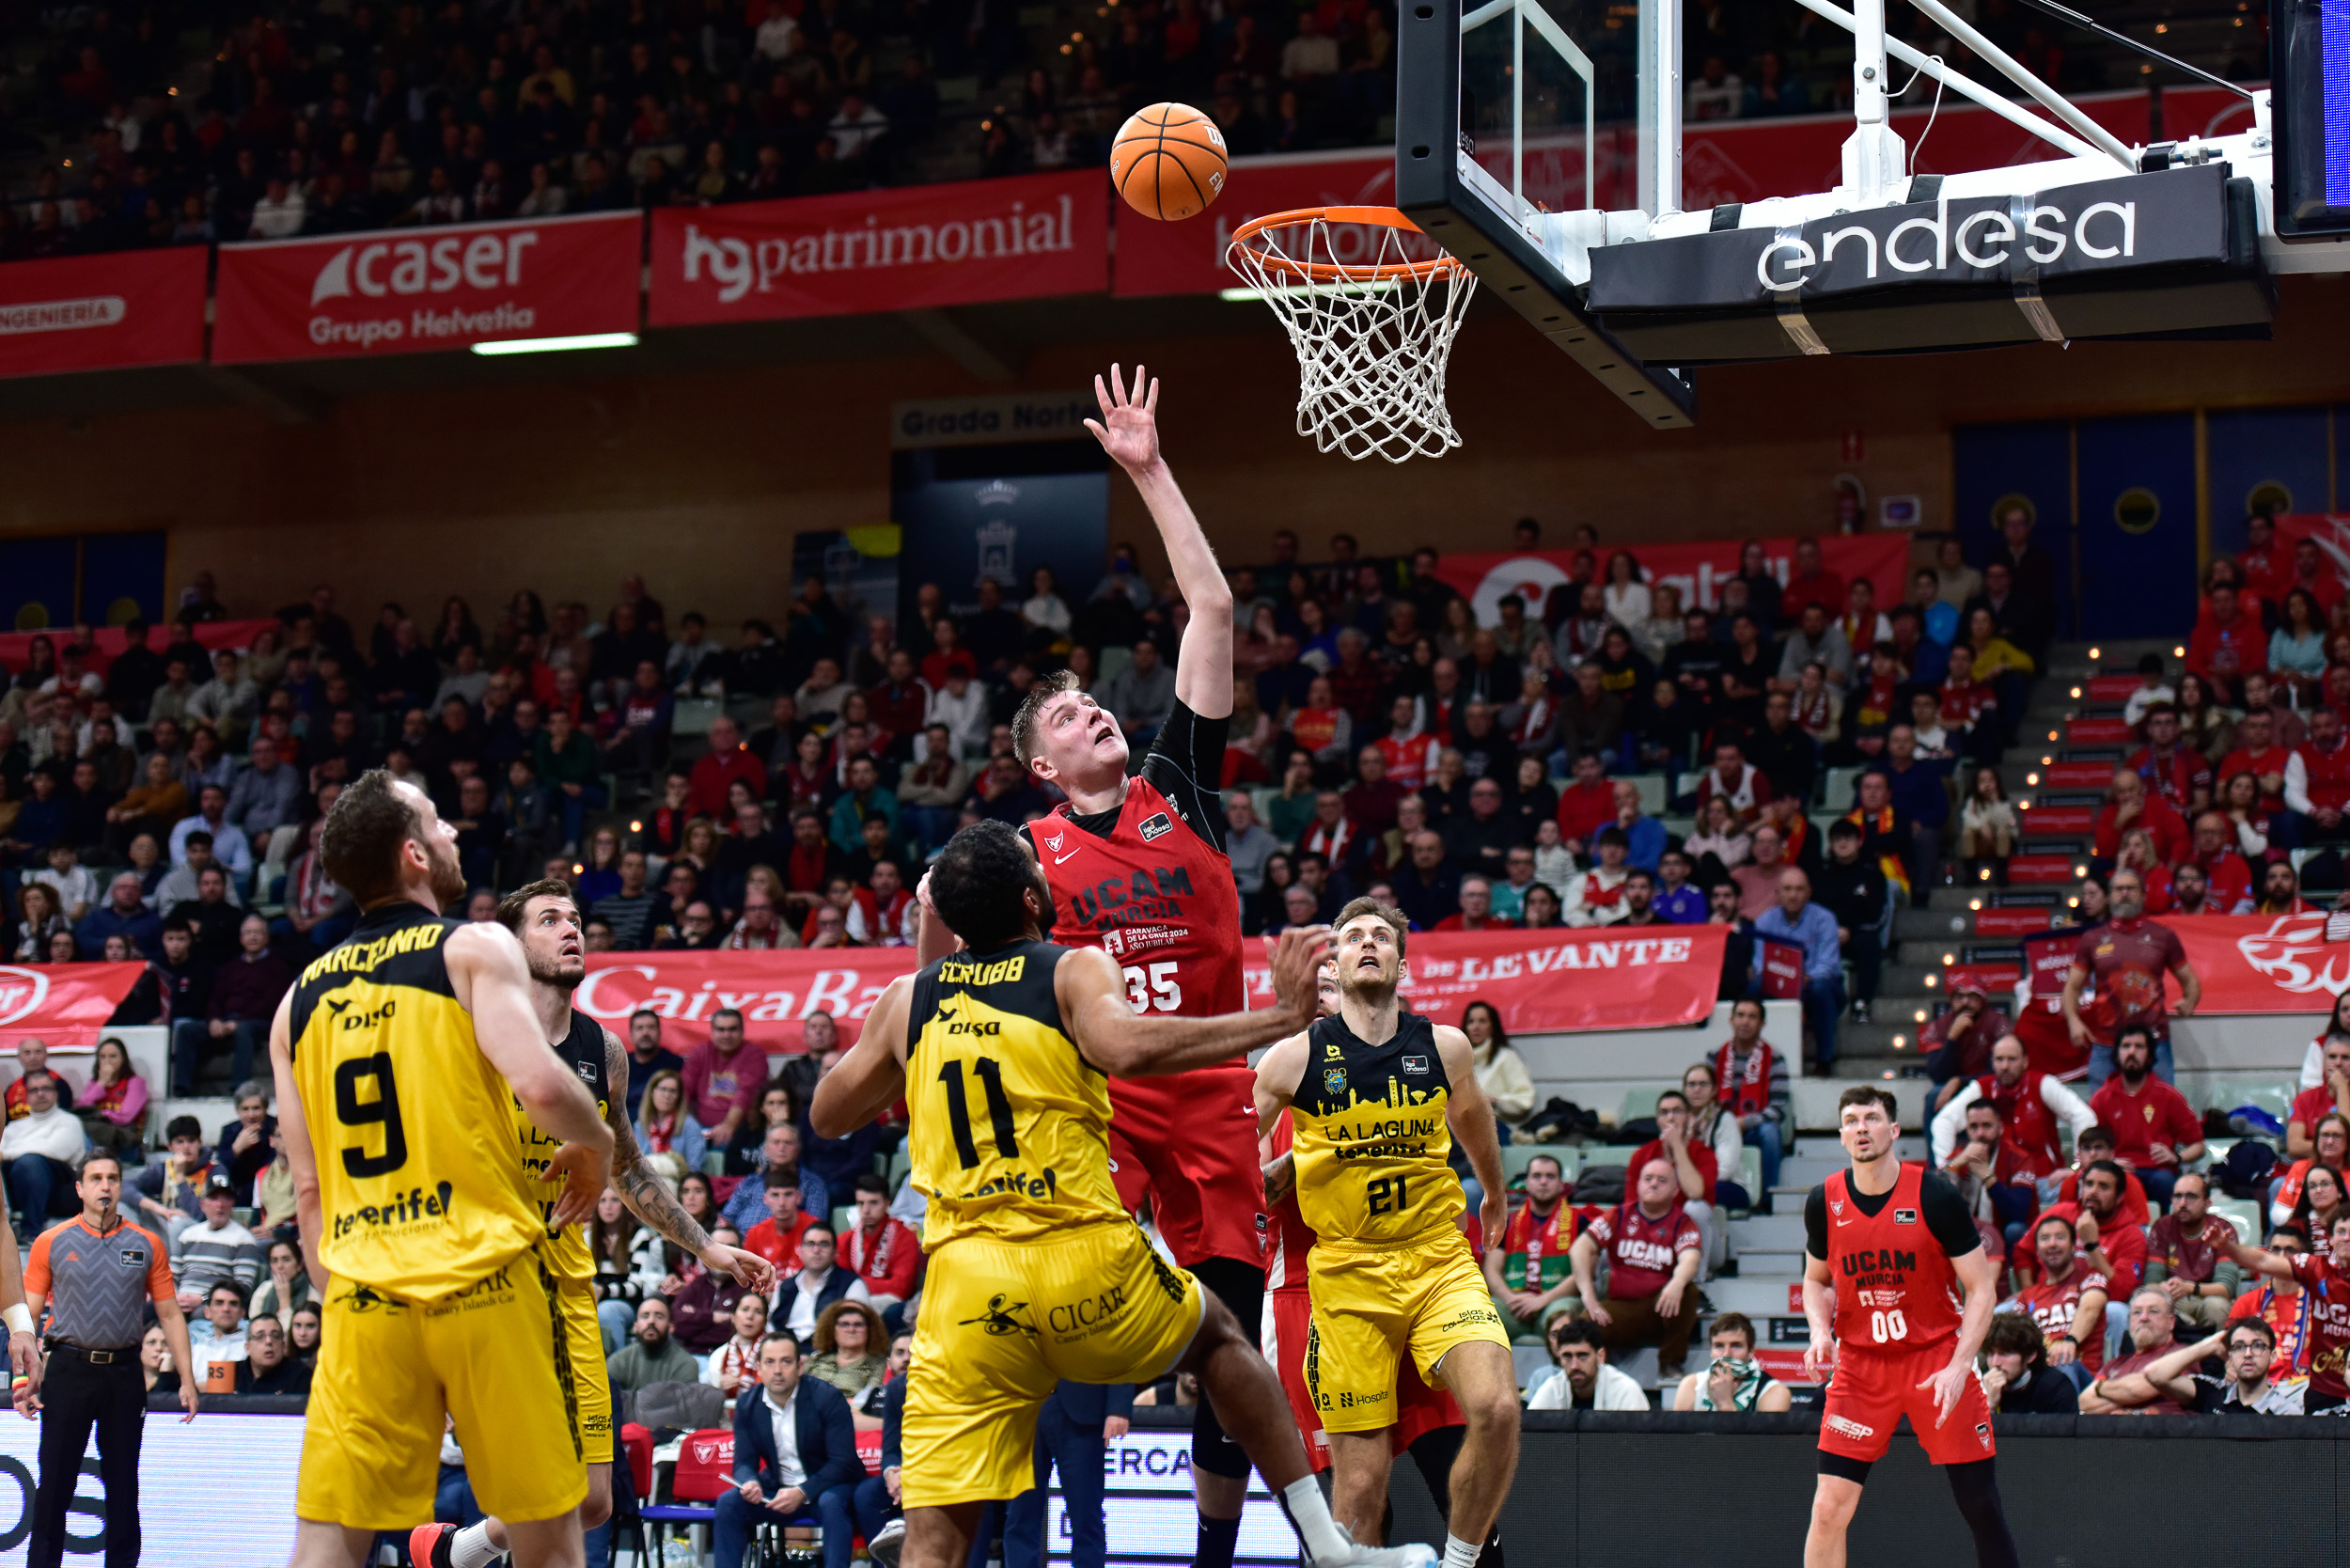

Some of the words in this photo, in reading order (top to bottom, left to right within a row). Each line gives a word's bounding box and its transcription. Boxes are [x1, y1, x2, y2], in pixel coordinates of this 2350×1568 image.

[753, 195, 1074, 292] patrimonial
[1757, 198, 2136, 291] endesa
[354, 231, 538, 297] caser
[309, 318, 403, 349] Grupo
[412, 301, 536, 338] Helvetia
[901, 405, 1000, 437] Grada
[1071, 865, 1195, 926] UCAM
[1096, 900, 1183, 933] MURCIA
[1125, 924, 1168, 935] CARAVACA
[1127, 933, 1137, 944] DE
[1148, 930, 1169, 939] CRUZ
[1168, 928, 1189, 938] 2024
[1129, 941, 1145, 951] AÑO
[1146, 938, 1175, 949] JUBILAR
[938, 955, 1026, 986] SCRUBB
[1459, 937, 1693, 983] LEVANTE
[1124, 961, 1182, 1014] 35
[334, 1051, 408, 1179] 9
[937, 1056, 1020, 1170] 11
[1324, 1124, 1353, 1142] LA
[1356, 1118, 1435, 1140] LAGUNA
[1367, 1174, 1407, 1216] 21
[1618, 1239, 1674, 1266] UCAM
[1841, 1248, 1917, 1277] UCAM
[1856, 1272, 1905, 1289] MURCIA
[1048, 1286, 1127, 1334] CICAR
[1458, 1309, 1484, 1319] Islas
[1871, 1309, 1908, 1344] 00
